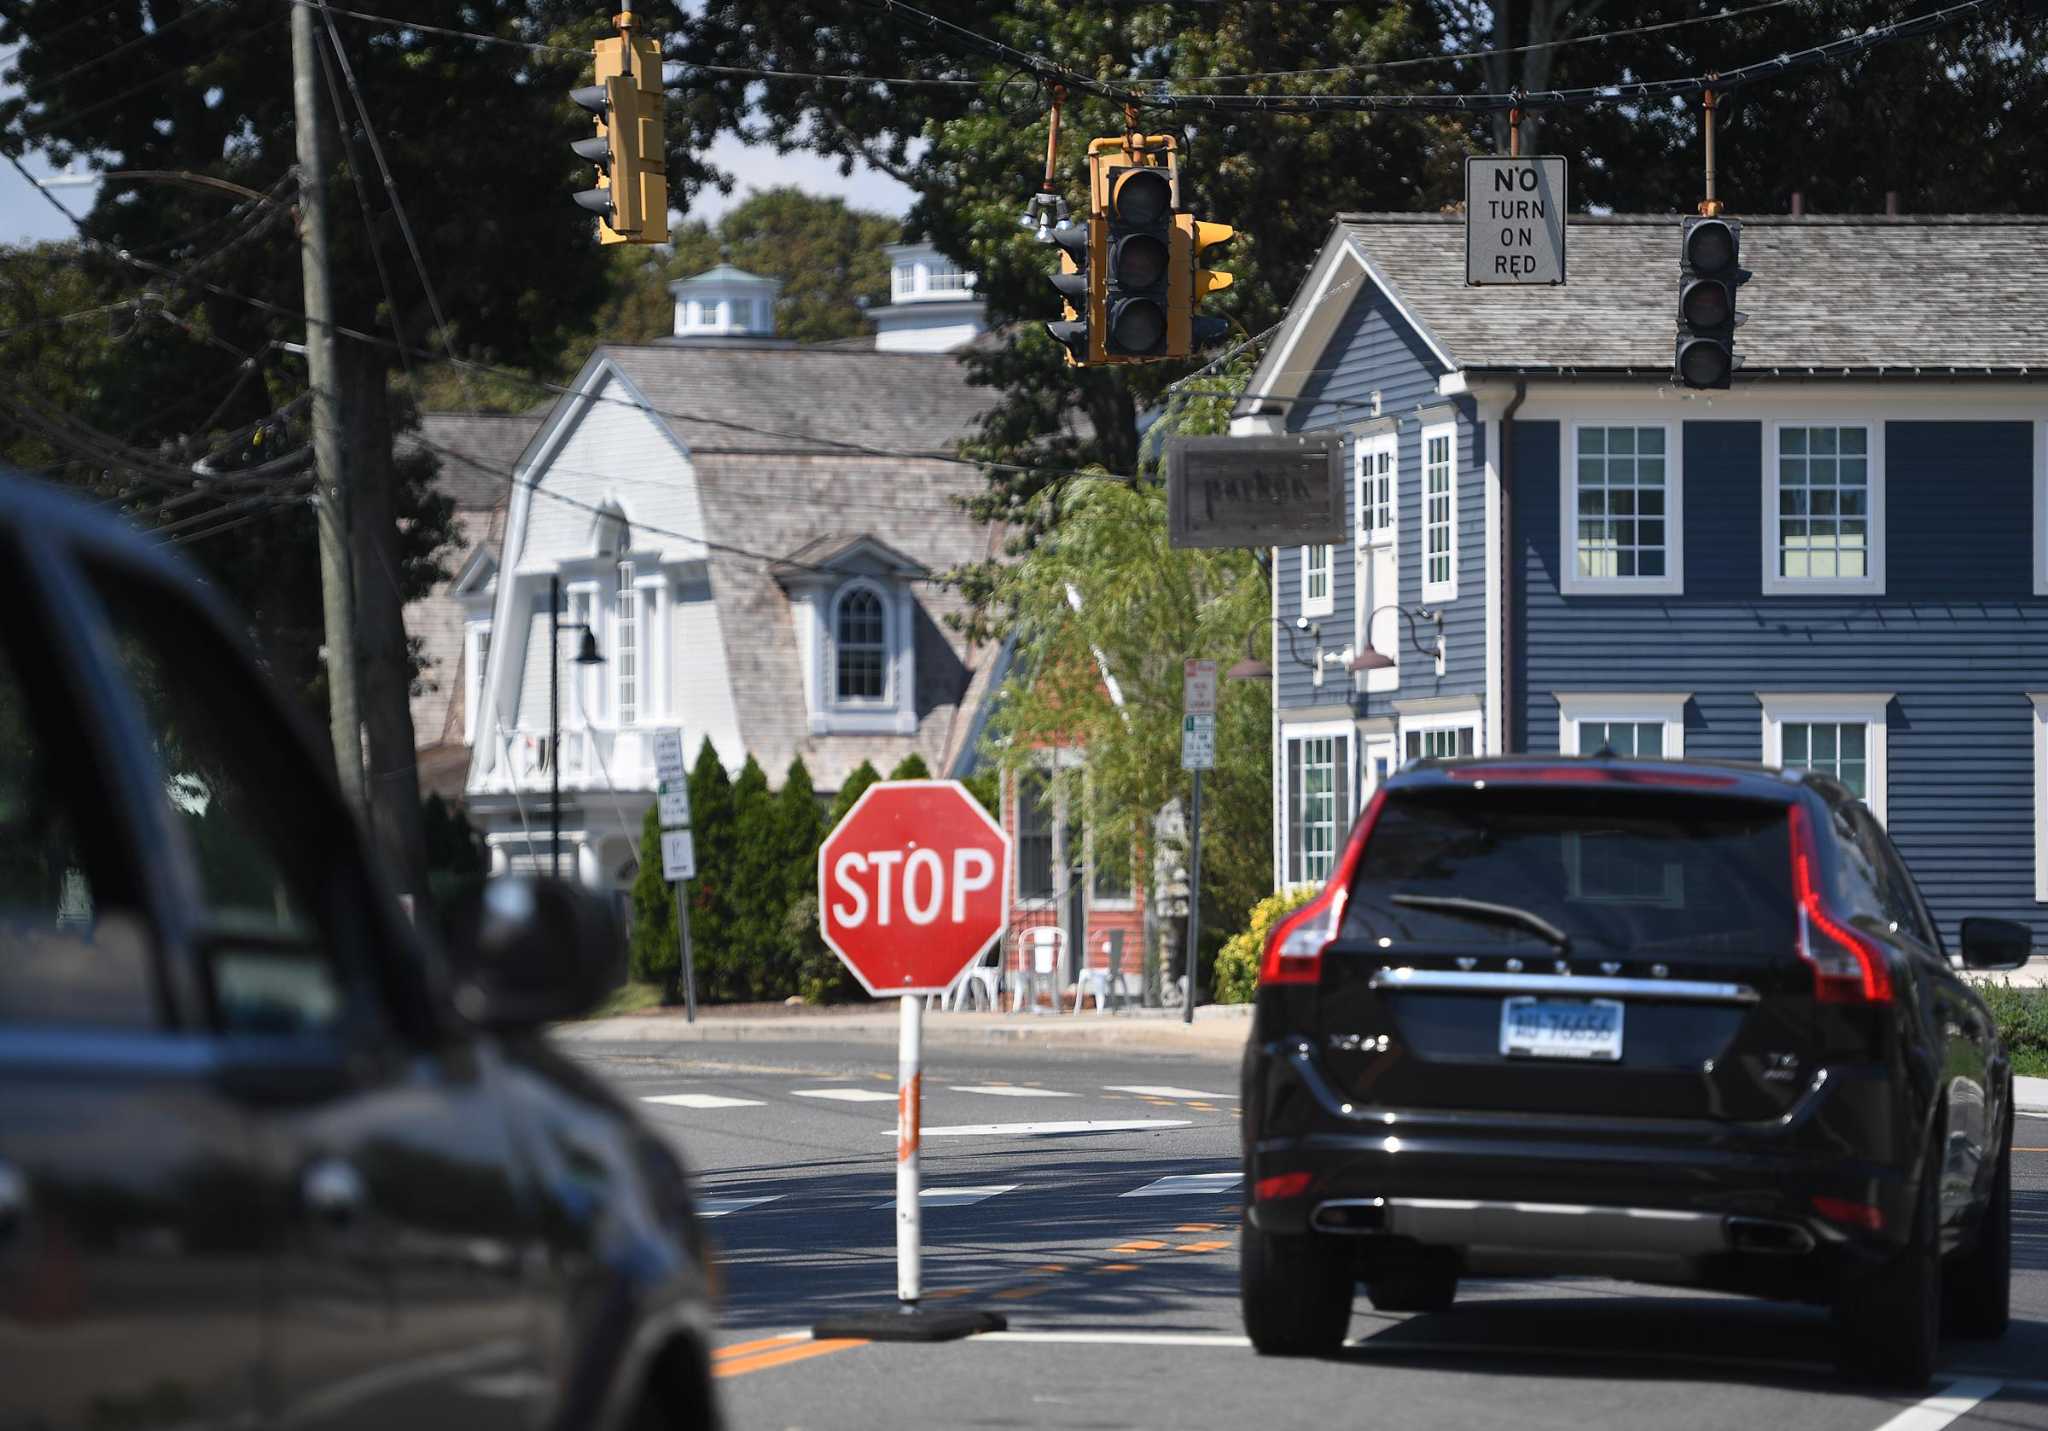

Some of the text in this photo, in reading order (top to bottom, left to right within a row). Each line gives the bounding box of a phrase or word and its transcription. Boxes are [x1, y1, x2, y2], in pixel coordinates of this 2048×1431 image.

[1494, 168, 1539, 192] NO
[1488, 200, 1545, 219] TURN
[1500, 228, 1531, 247] ON
[1495, 255, 1537, 275] RED
[832, 848, 995, 929] STOP
